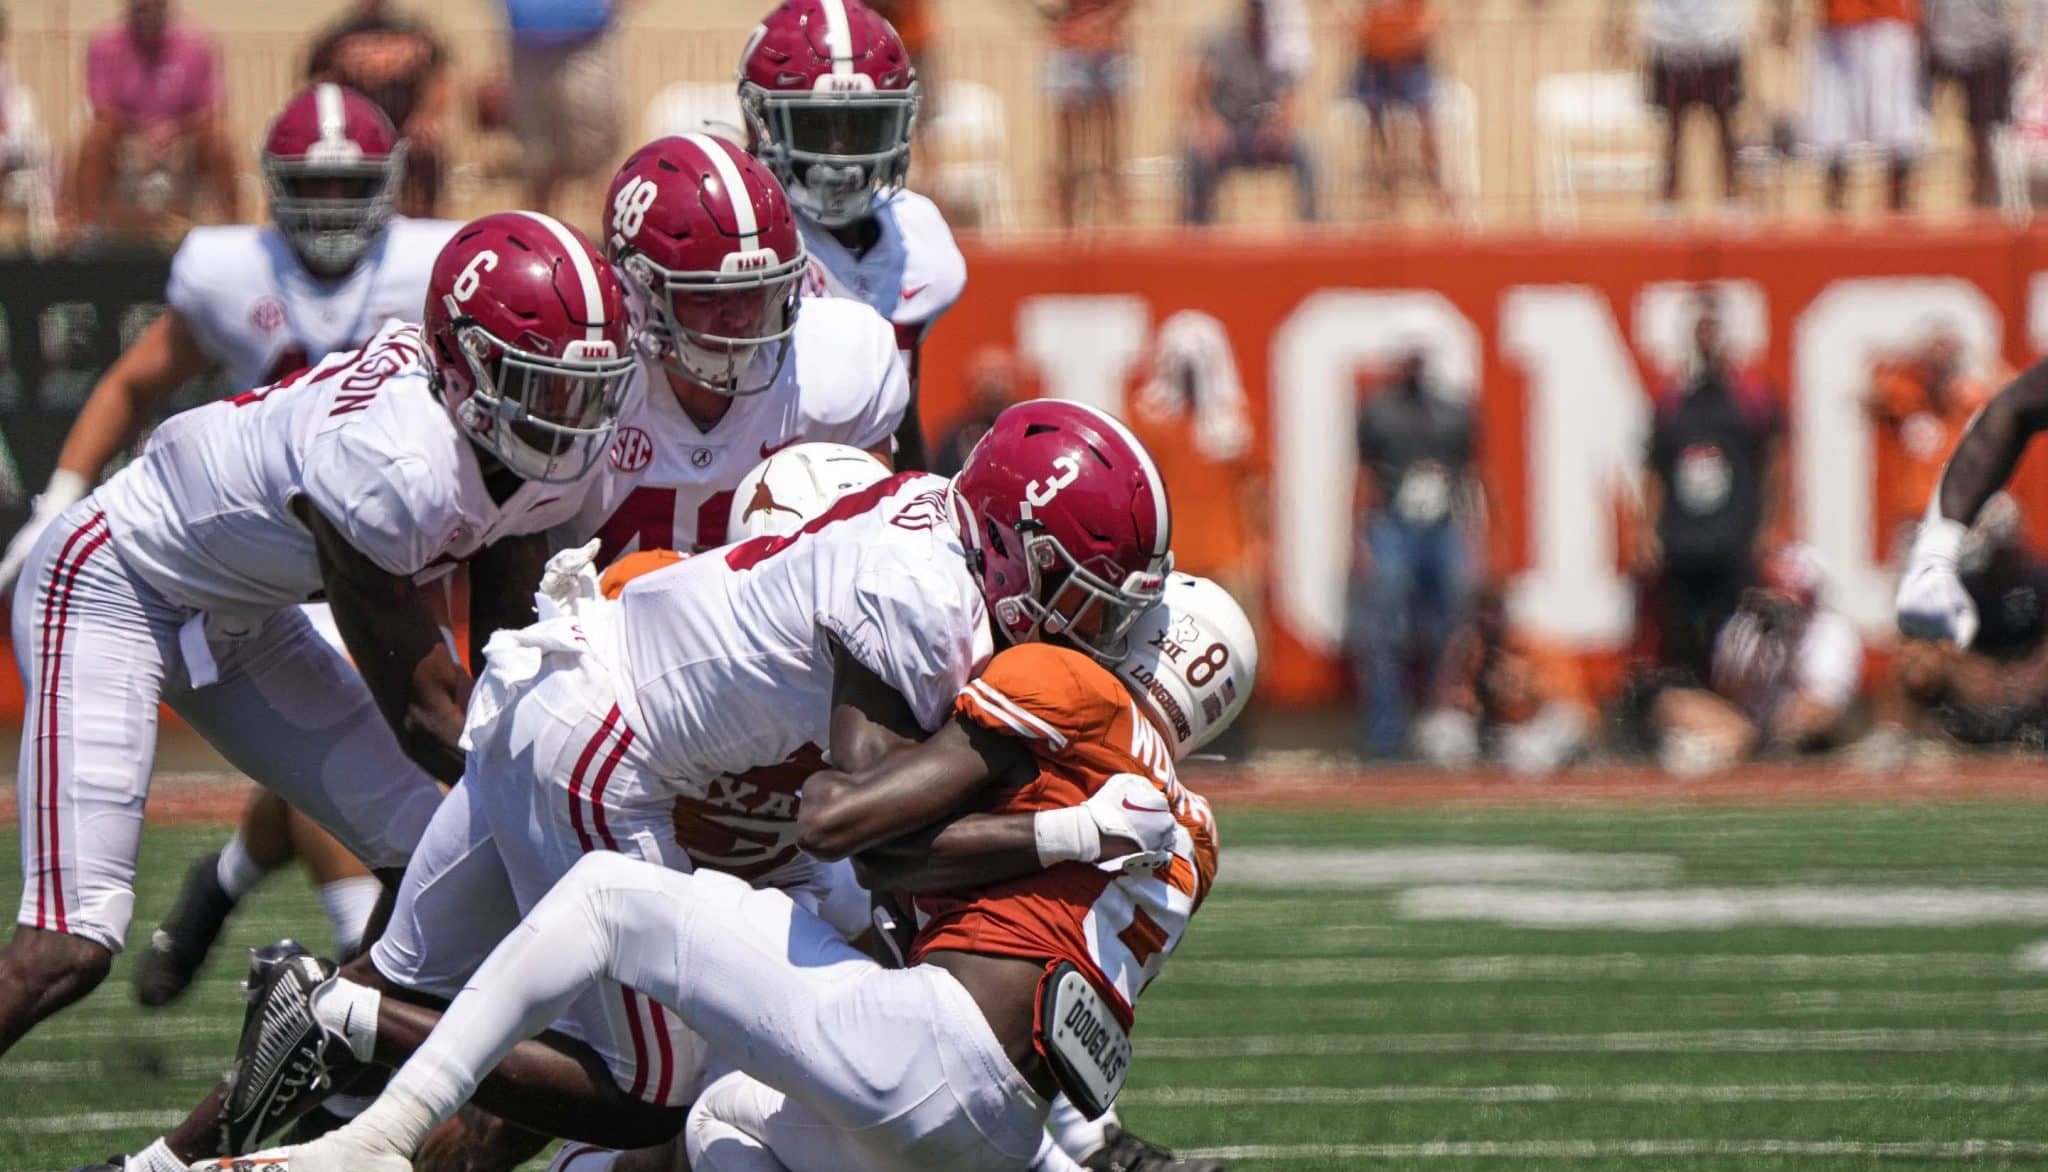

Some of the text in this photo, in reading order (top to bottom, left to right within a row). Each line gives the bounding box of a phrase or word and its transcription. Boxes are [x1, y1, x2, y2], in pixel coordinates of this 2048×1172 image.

[612, 175, 658, 238] 48
[453, 250, 499, 302] 6
[611, 427, 652, 473] SEC
[1026, 456, 1080, 507] 3
[1186, 643, 1229, 688] 8
[1130, 664, 1192, 743] LONGHORNS
[1064, 998, 1123, 1082] DOUGLAS
